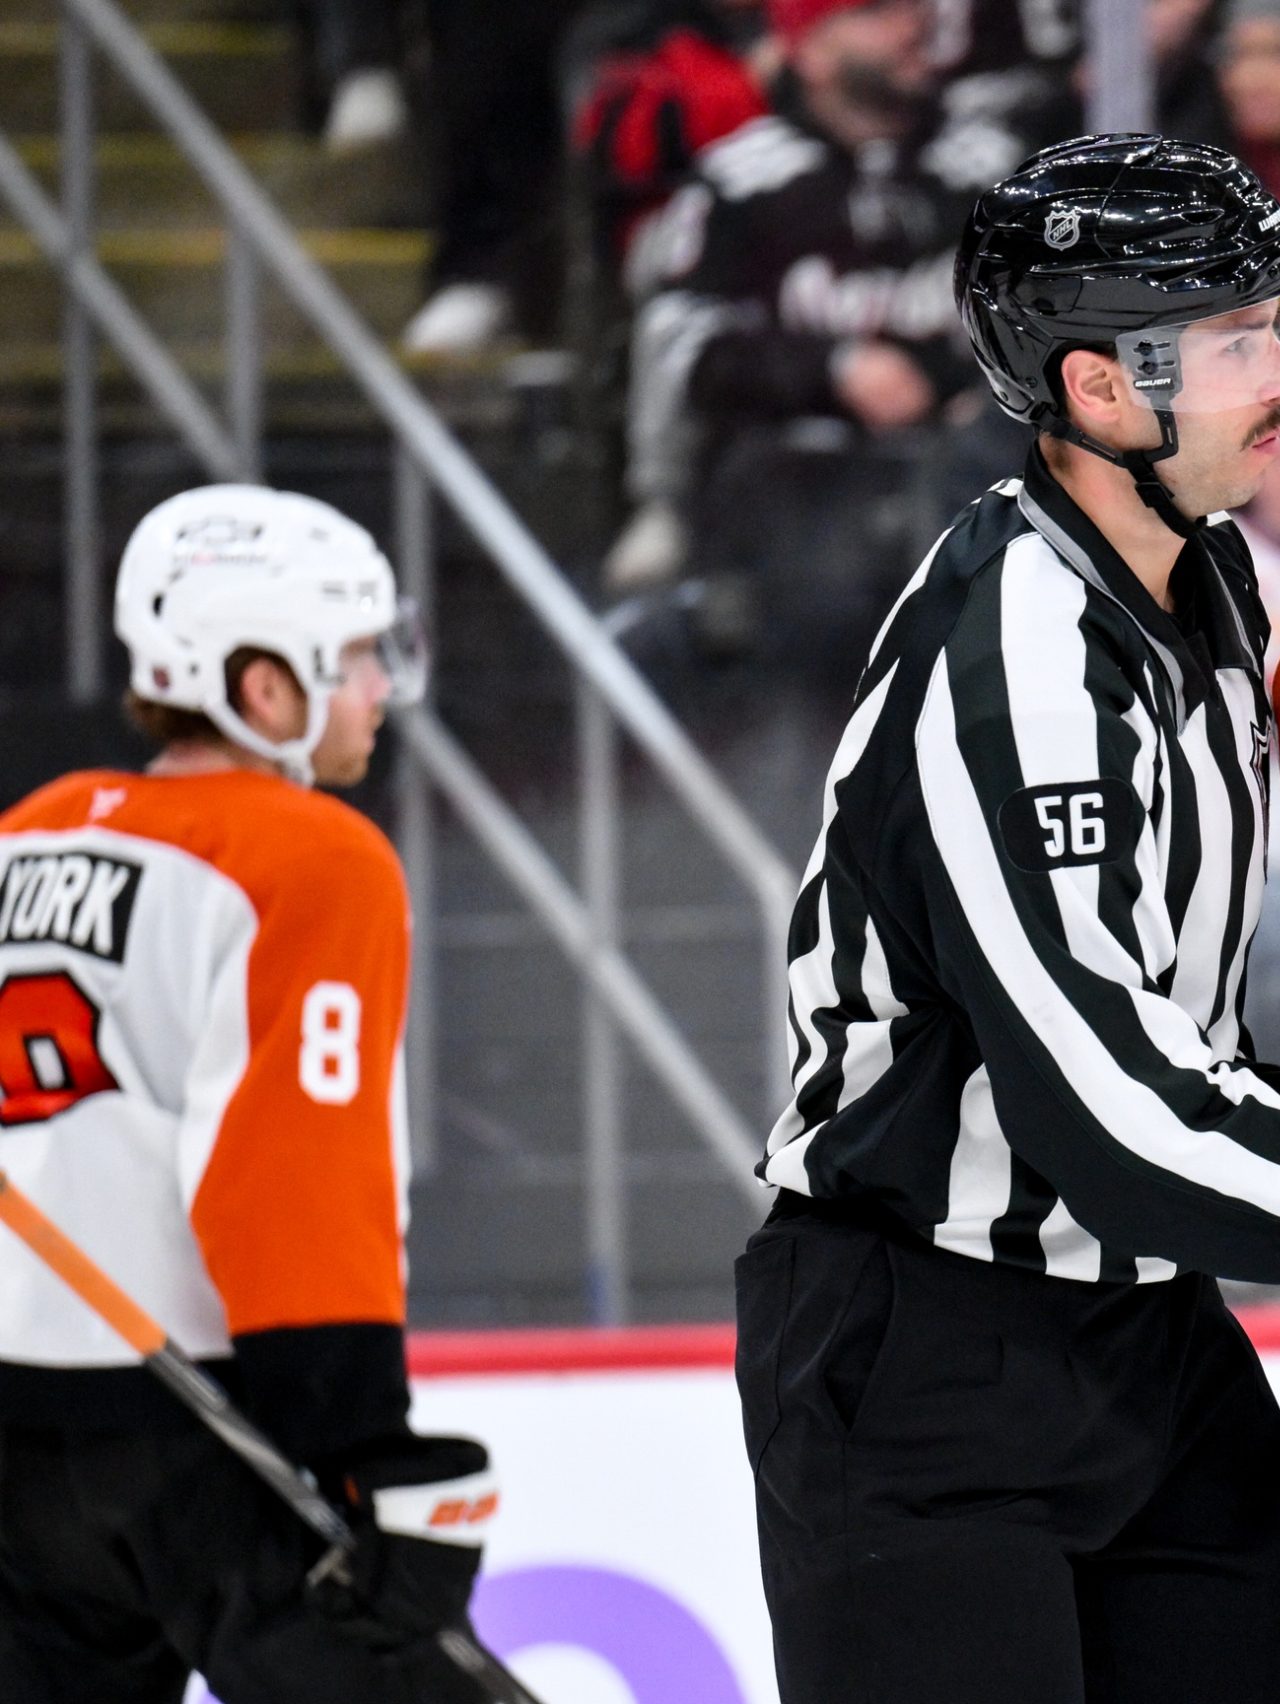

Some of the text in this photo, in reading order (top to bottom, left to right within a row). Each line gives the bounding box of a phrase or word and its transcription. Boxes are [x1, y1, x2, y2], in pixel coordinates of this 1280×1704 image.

[1033, 791, 1106, 858] 56
[0, 854, 130, 955] YORK
[298, 979, 362, 1106] 8
